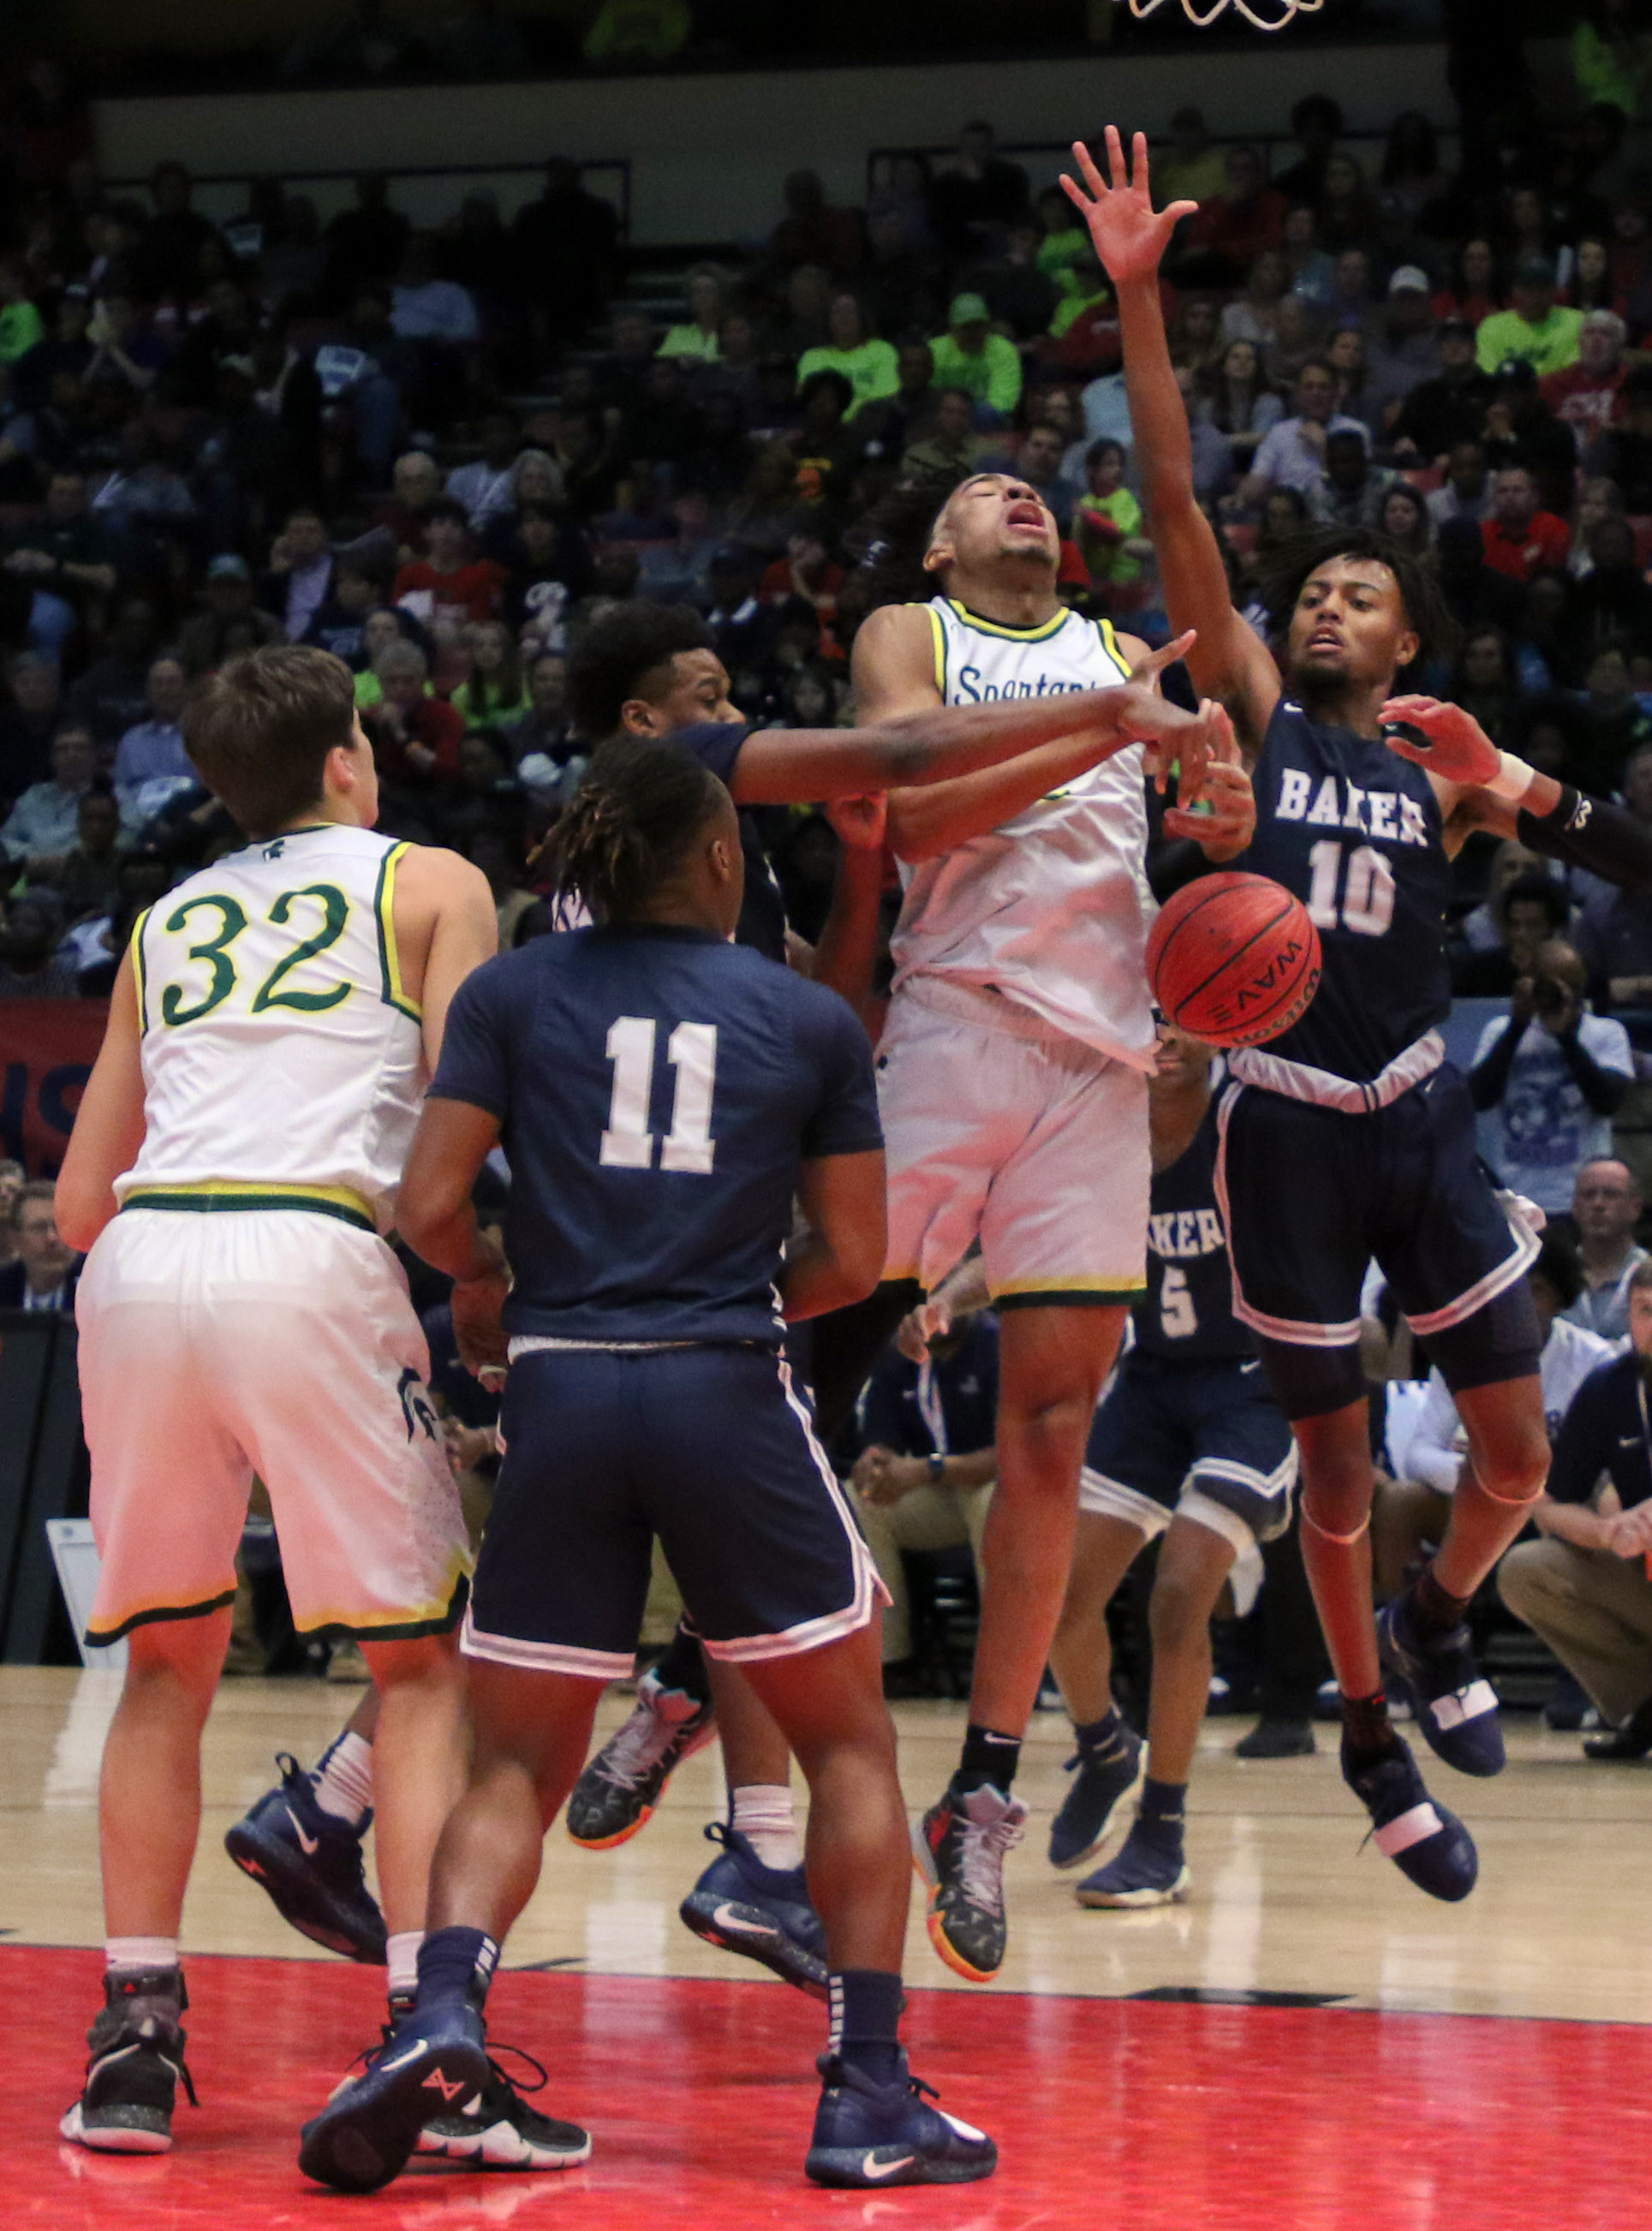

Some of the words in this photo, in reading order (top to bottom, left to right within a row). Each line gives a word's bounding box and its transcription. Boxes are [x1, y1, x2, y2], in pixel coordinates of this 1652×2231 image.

[1305, 839, 1396, 937] 10
[161, 883, 354, 1027] 32
[1207, 940, 1303, 1025] WAVE
[599, 1016, 718, 1175] 11
[1148, 1208, 1226, 1257] KER
[1160, 1265, 1199, 1339] 5
